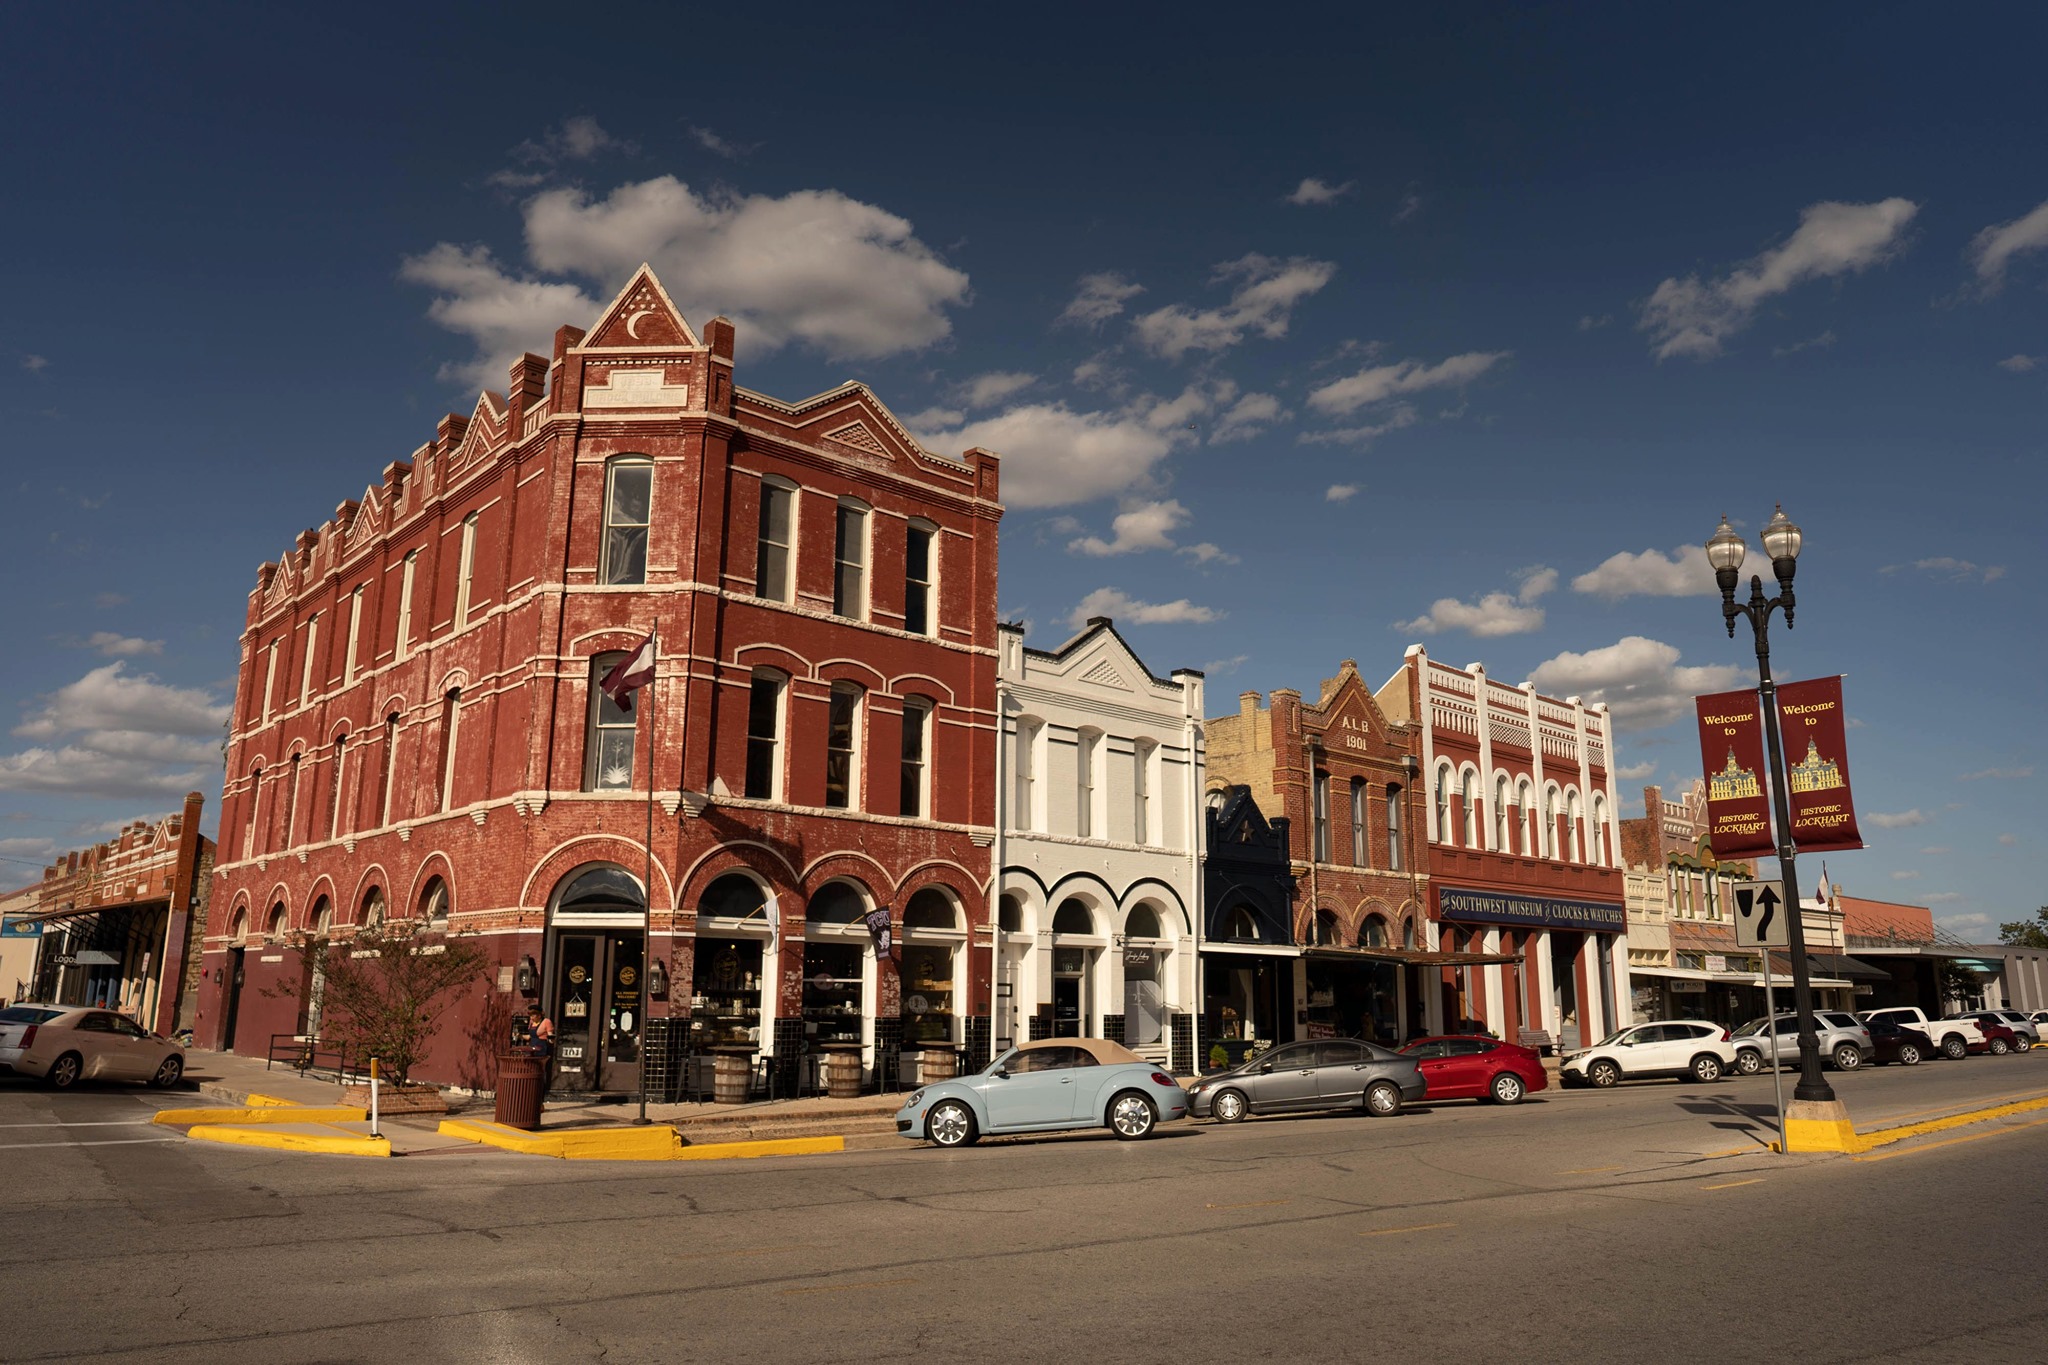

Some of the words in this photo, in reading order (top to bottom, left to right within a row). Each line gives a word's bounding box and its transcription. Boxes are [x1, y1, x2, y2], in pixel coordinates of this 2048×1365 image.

[1783, 701, 1835, 715] Welcome
[1704, 713, 1754, 725] Welcome
[1804, 717, 1817, 726] to
[1724, 727, 1736, 736] to
[1346, 735, 1367, 751] 1901
[1800, 804, 1841, 816] HISTORIC
[1719, 813, 1759, 823] HISTORIC
[1795, 814, 1850, 828] LOCKHART
[1714, 822, 1767, 835] LOCKHART
[1450, 895, 1506, 914] SOUTHWEST
[1508, 900, 1543, 917] MUSEUM
[1552, 904, 1583, 920] CLOCKS
[1583, 908, 1590, 920] &
[1590, 908, 1622, 923] WATCHES
[866, 910, 890, 931] TCU
